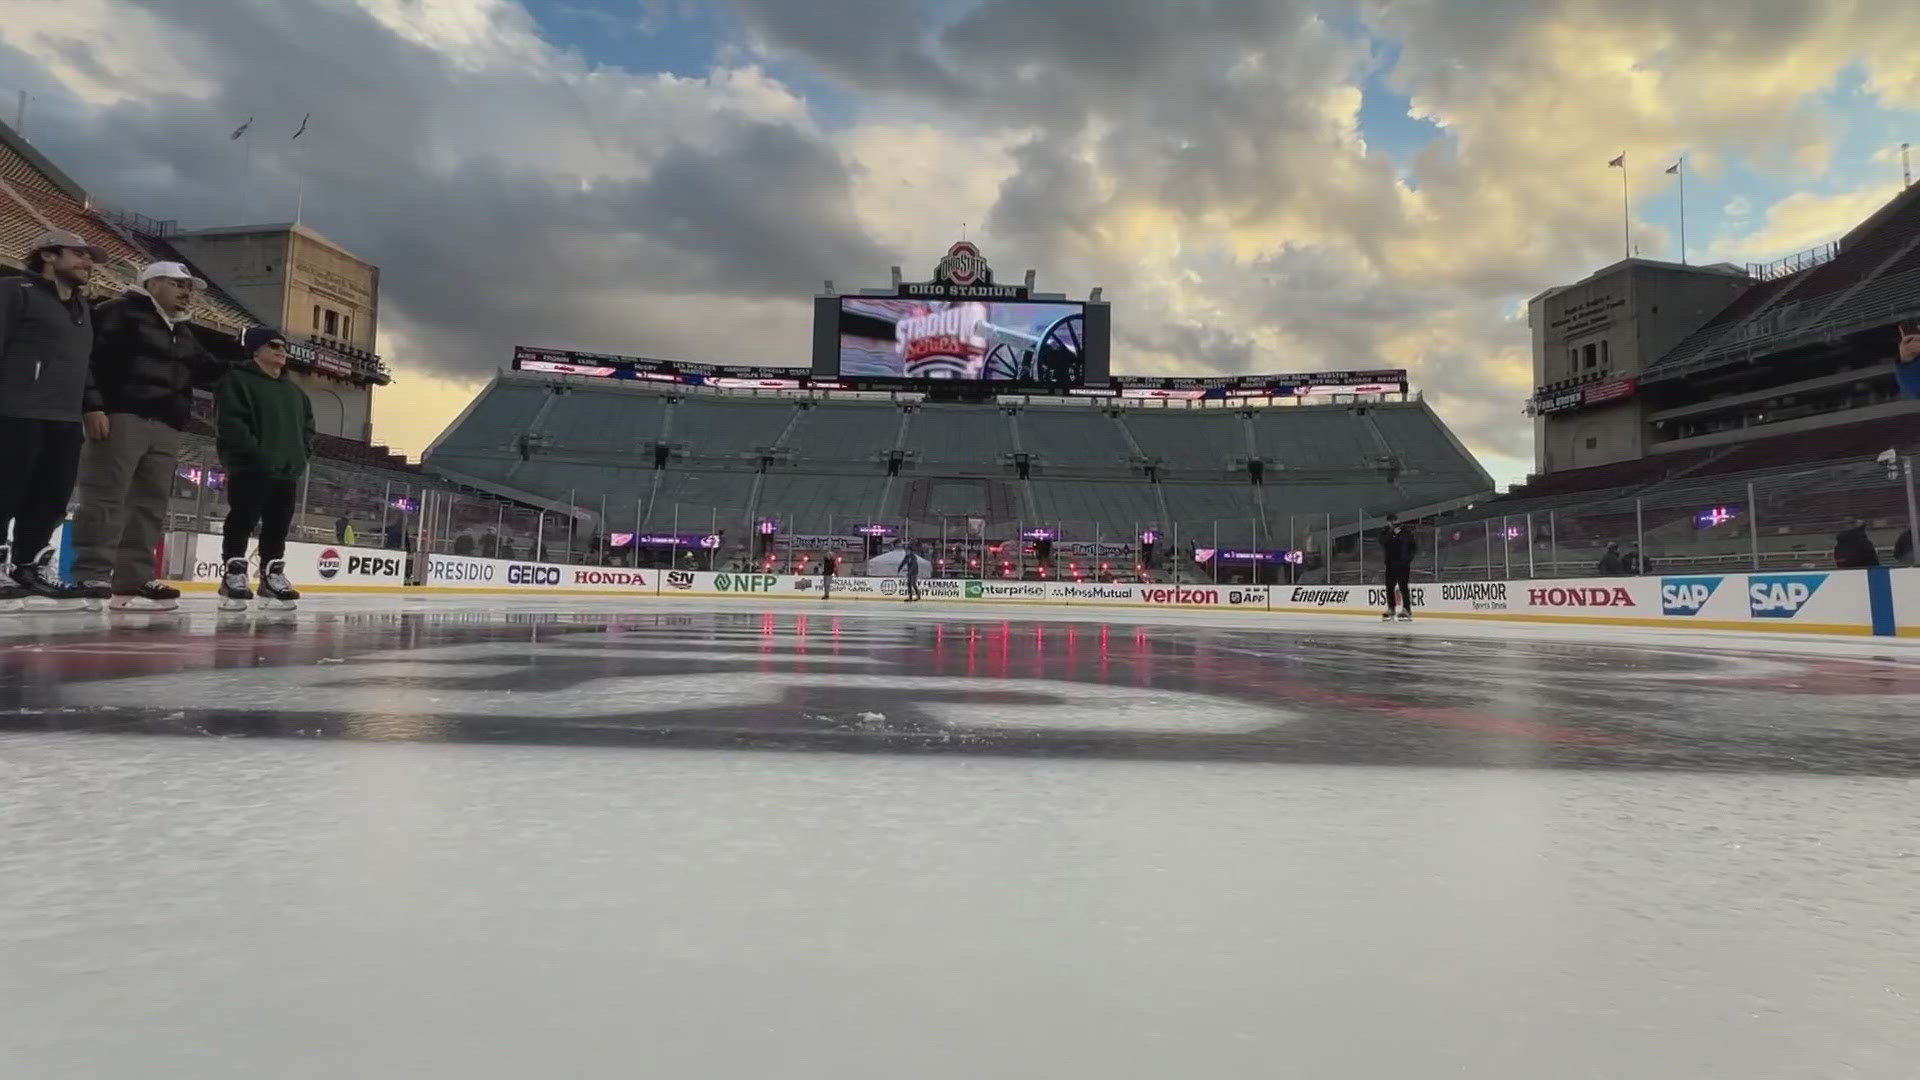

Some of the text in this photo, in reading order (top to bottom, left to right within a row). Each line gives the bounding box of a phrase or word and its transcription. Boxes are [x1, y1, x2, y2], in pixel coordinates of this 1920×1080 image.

[909, 284, 1017, 297] OHIO STADIUM
[348, 556, 400, 576] PEPSI
[508, 564, 560, 585] GEICO
[574, 571, 646, 586] HONDA
[667, 571, 694, 585] SN
[735, 575, 777, 592] NFP
[931, 589, 959, 598] UNION
[1064, 586, 1132, 598] MassMutual
[1141, 585, 1218, 604] verizon
[1291, 587, 1350, 605] Energizer
[1368, 588, 1425, 607] DISER
[1442, 584, 1506, 601] BODYARMOR
[1528, 587, 1636, 607] HONDA
[1662, 584, 1712, 608] SAP
[1750, 583, 1809, 610] SAP
